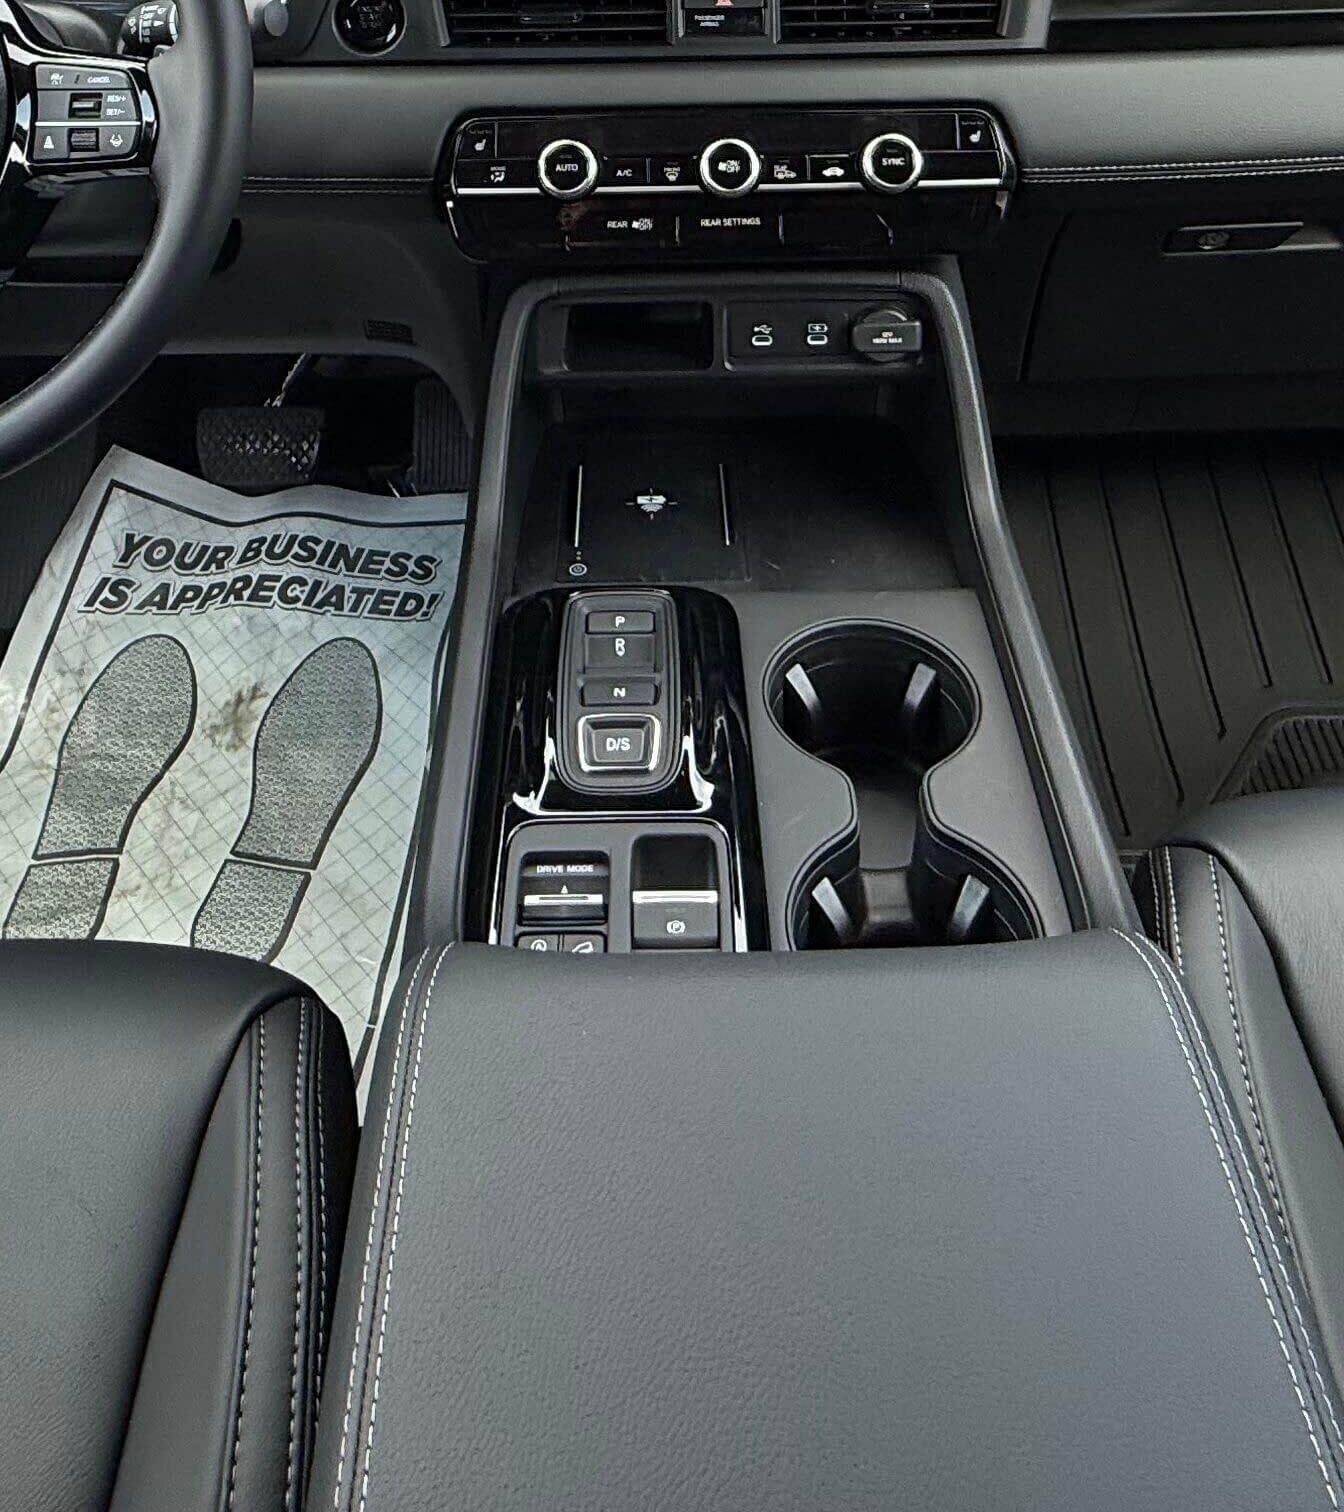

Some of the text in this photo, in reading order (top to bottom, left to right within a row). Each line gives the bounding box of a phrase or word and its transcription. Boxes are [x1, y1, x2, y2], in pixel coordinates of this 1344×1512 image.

[882, 157, 906, 166] SYNC
[555, 163, 579, 172] AUTO
[615, 169, 633, 177] A/C
[607, 220, 628, 229] REAR
[700, 217, 761, 227] REAR SETTINGS
[114, 530, 442, 583] YOUR BUSINESS
[80, 573, 443, 621] IS APPRECIATED!
[615, 616, 626, 628] P
[615, 638, 626, 651] R
[613, 687, 626, 698] N
[605, 737, 631, 752] D/S
[536, 863, 594, 874] DRIVE MODE
